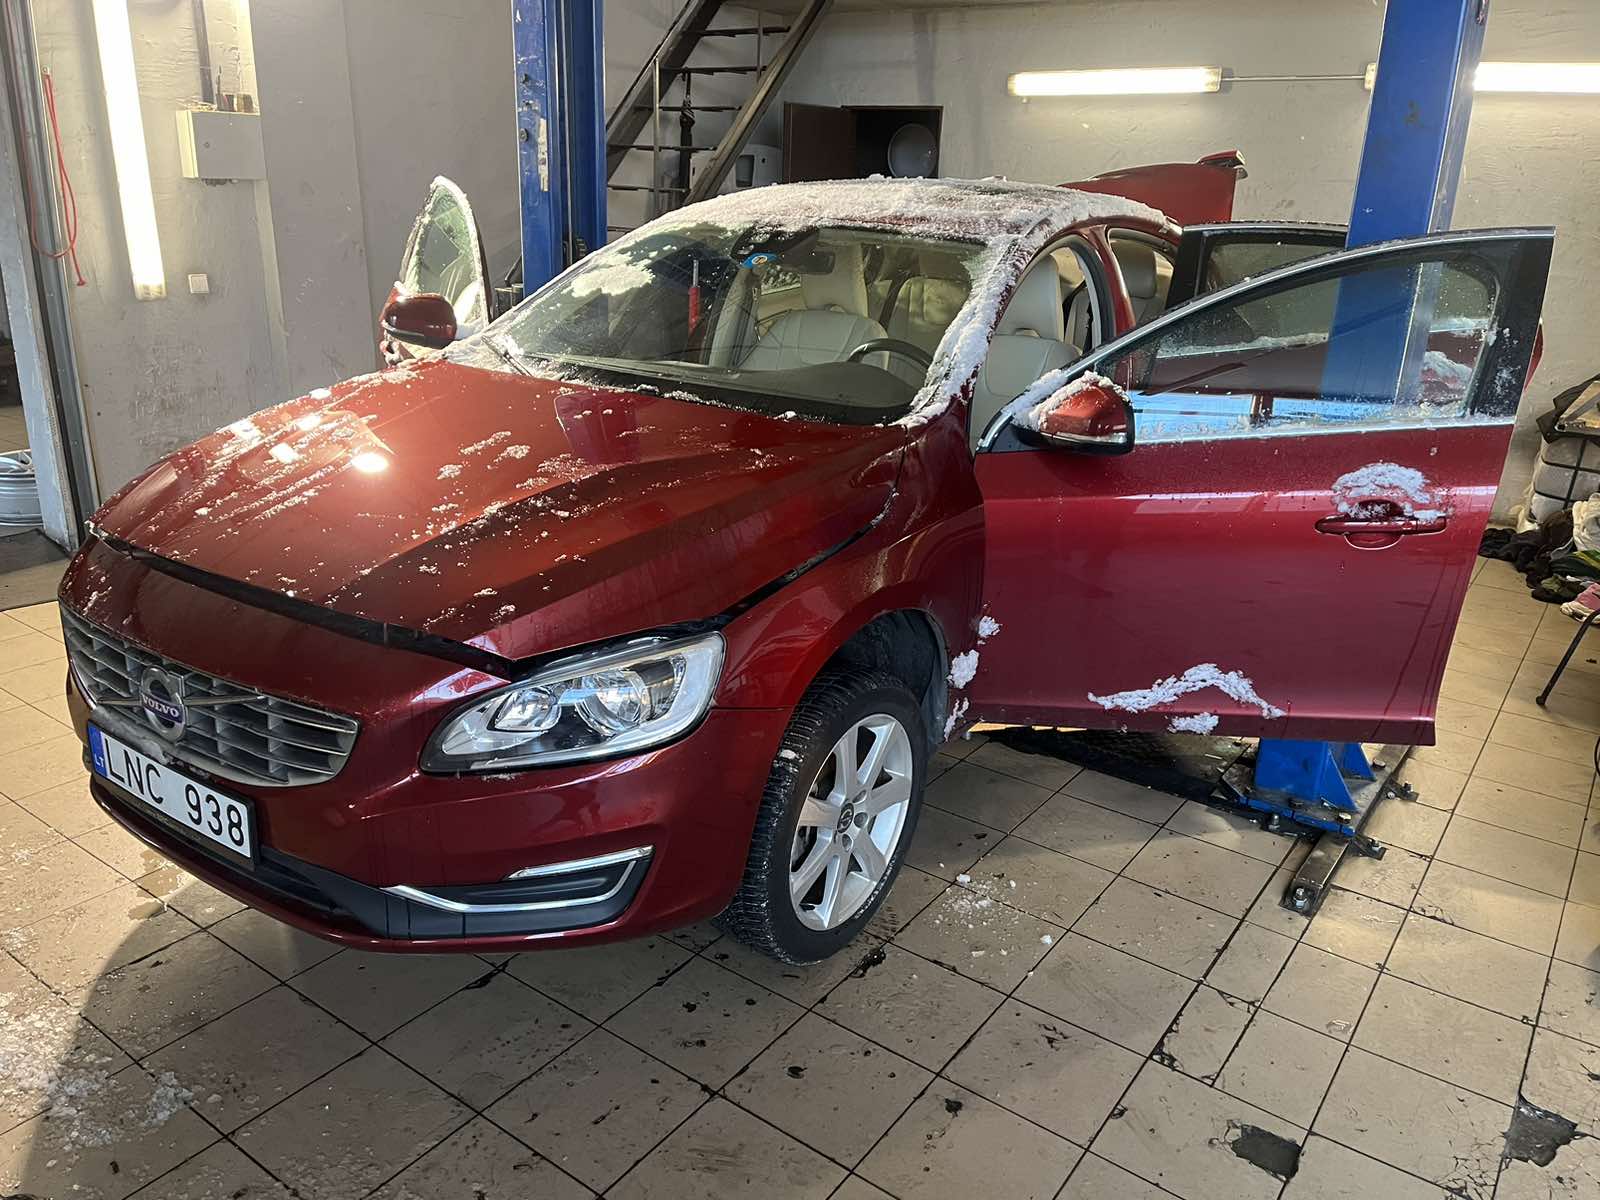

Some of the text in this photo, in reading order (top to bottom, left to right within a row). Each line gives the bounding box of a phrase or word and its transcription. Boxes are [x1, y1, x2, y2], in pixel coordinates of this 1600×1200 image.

[142, 695, 180, 718] VOLVO
[94, 753, 104, 768] LT
[104, 738, 164, 804] LNC
[185, 785, 244, 847] 938
